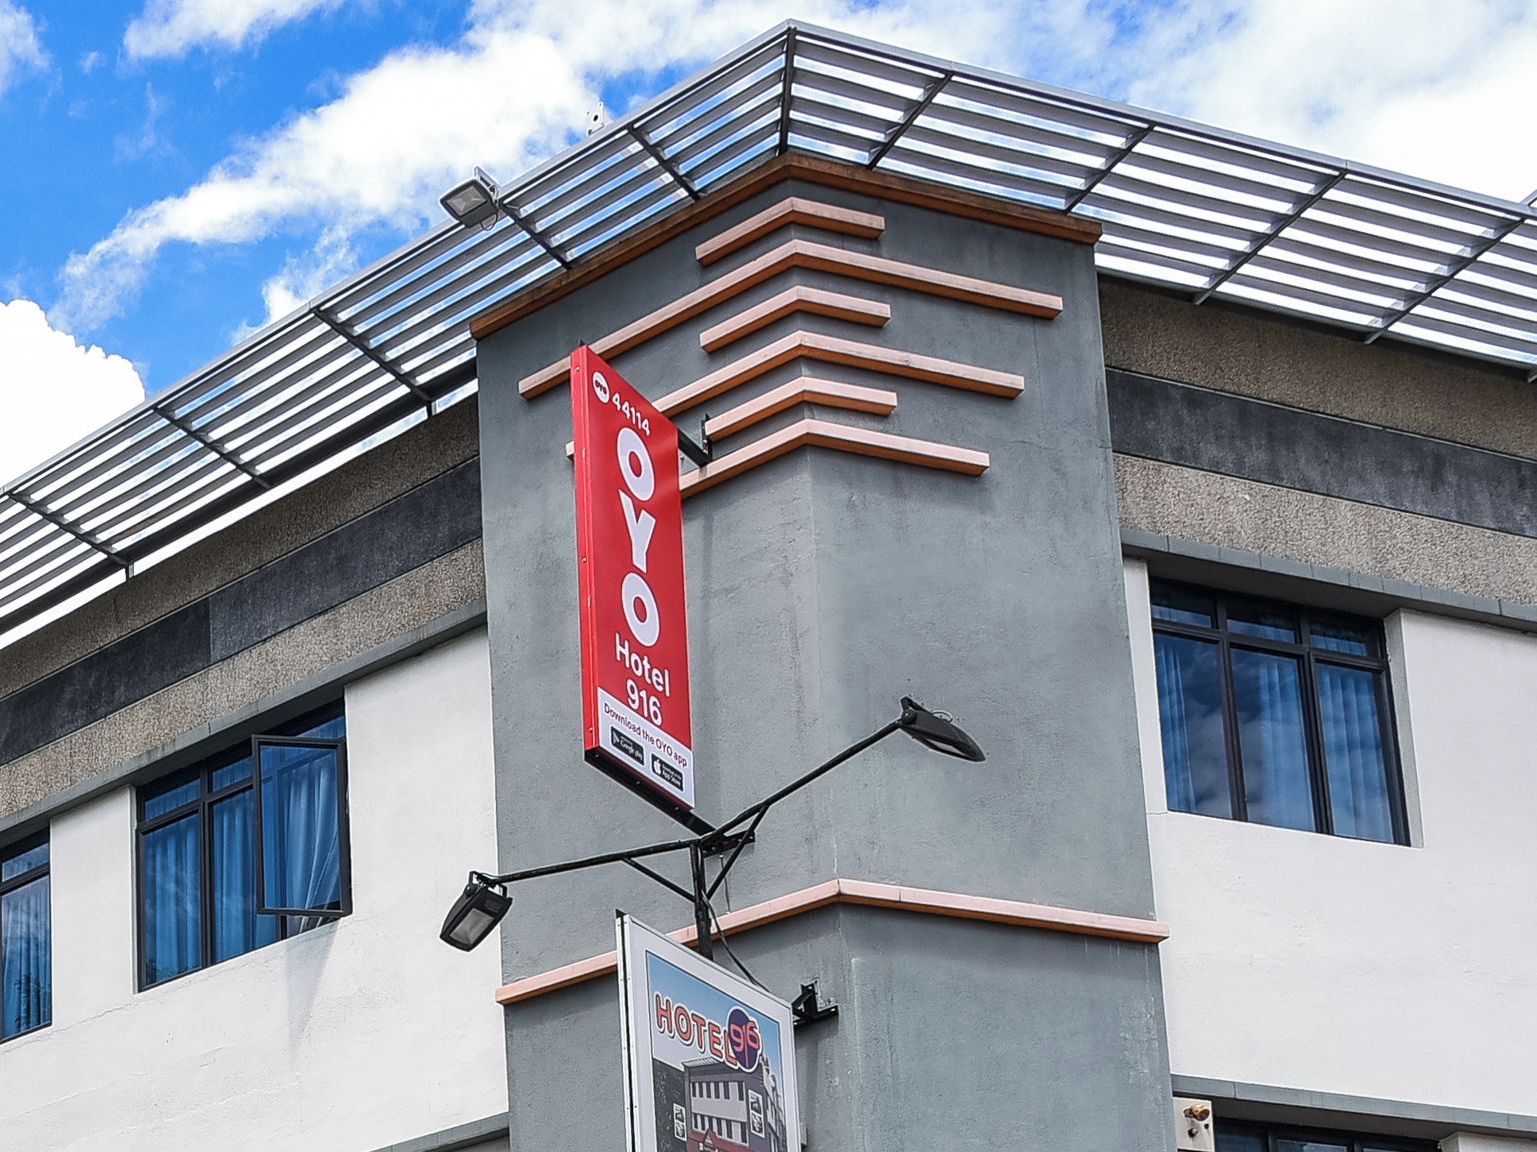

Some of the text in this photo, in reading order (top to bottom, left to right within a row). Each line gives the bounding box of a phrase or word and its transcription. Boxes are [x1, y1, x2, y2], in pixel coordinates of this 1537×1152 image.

[612, 392, 650, 436] 44114
[617, 427, 660, 647] OYO
[615, 632, 670, 697] Hotel
[604, 702, 641, 735] Download
[642, 729, 654, 745] the
[655, 738, 673, 756] OYO
[674, 753, 687, 768] app
[626, 679, 662, 726] 916
[655, 993, 760, 1067] HOTEL 916
